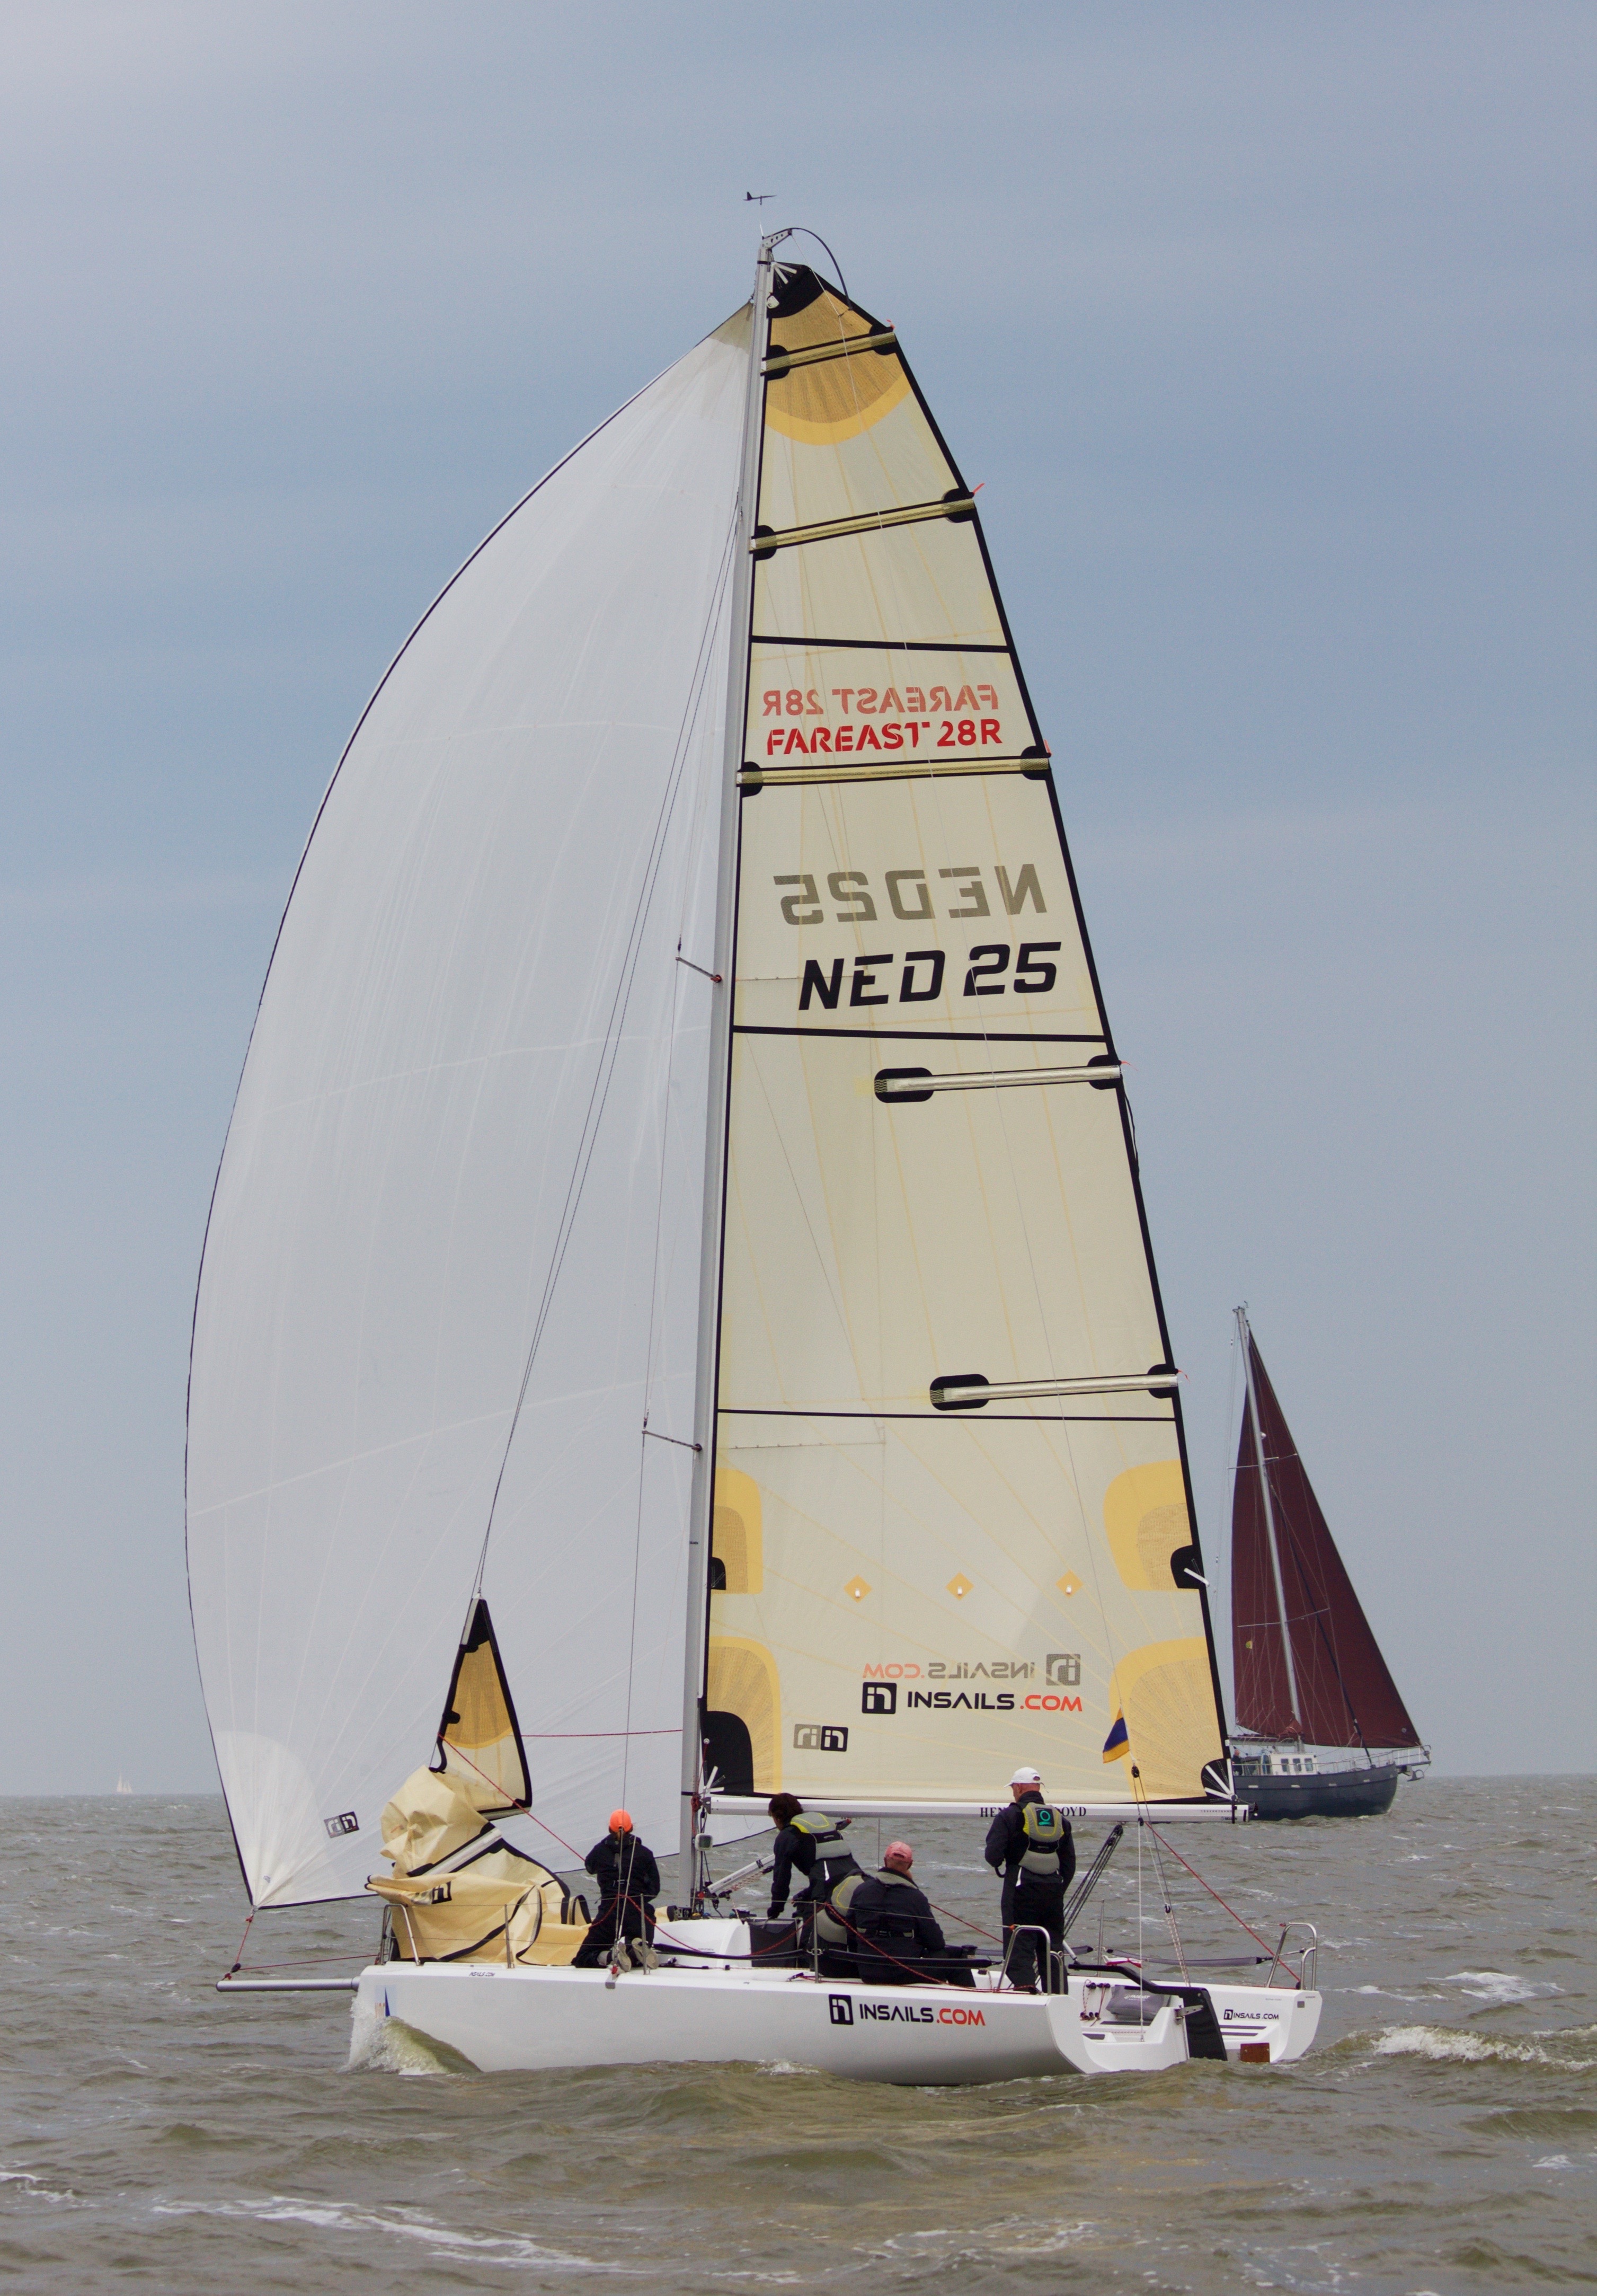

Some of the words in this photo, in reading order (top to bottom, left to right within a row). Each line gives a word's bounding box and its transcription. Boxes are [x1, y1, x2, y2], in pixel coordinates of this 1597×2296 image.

[767, 721, 930, 755] FAREAST
[937, 719, 1002, 747] 28R
[798, 950, 945, 1011] NED
[963, 941, 1062, 997] 25
